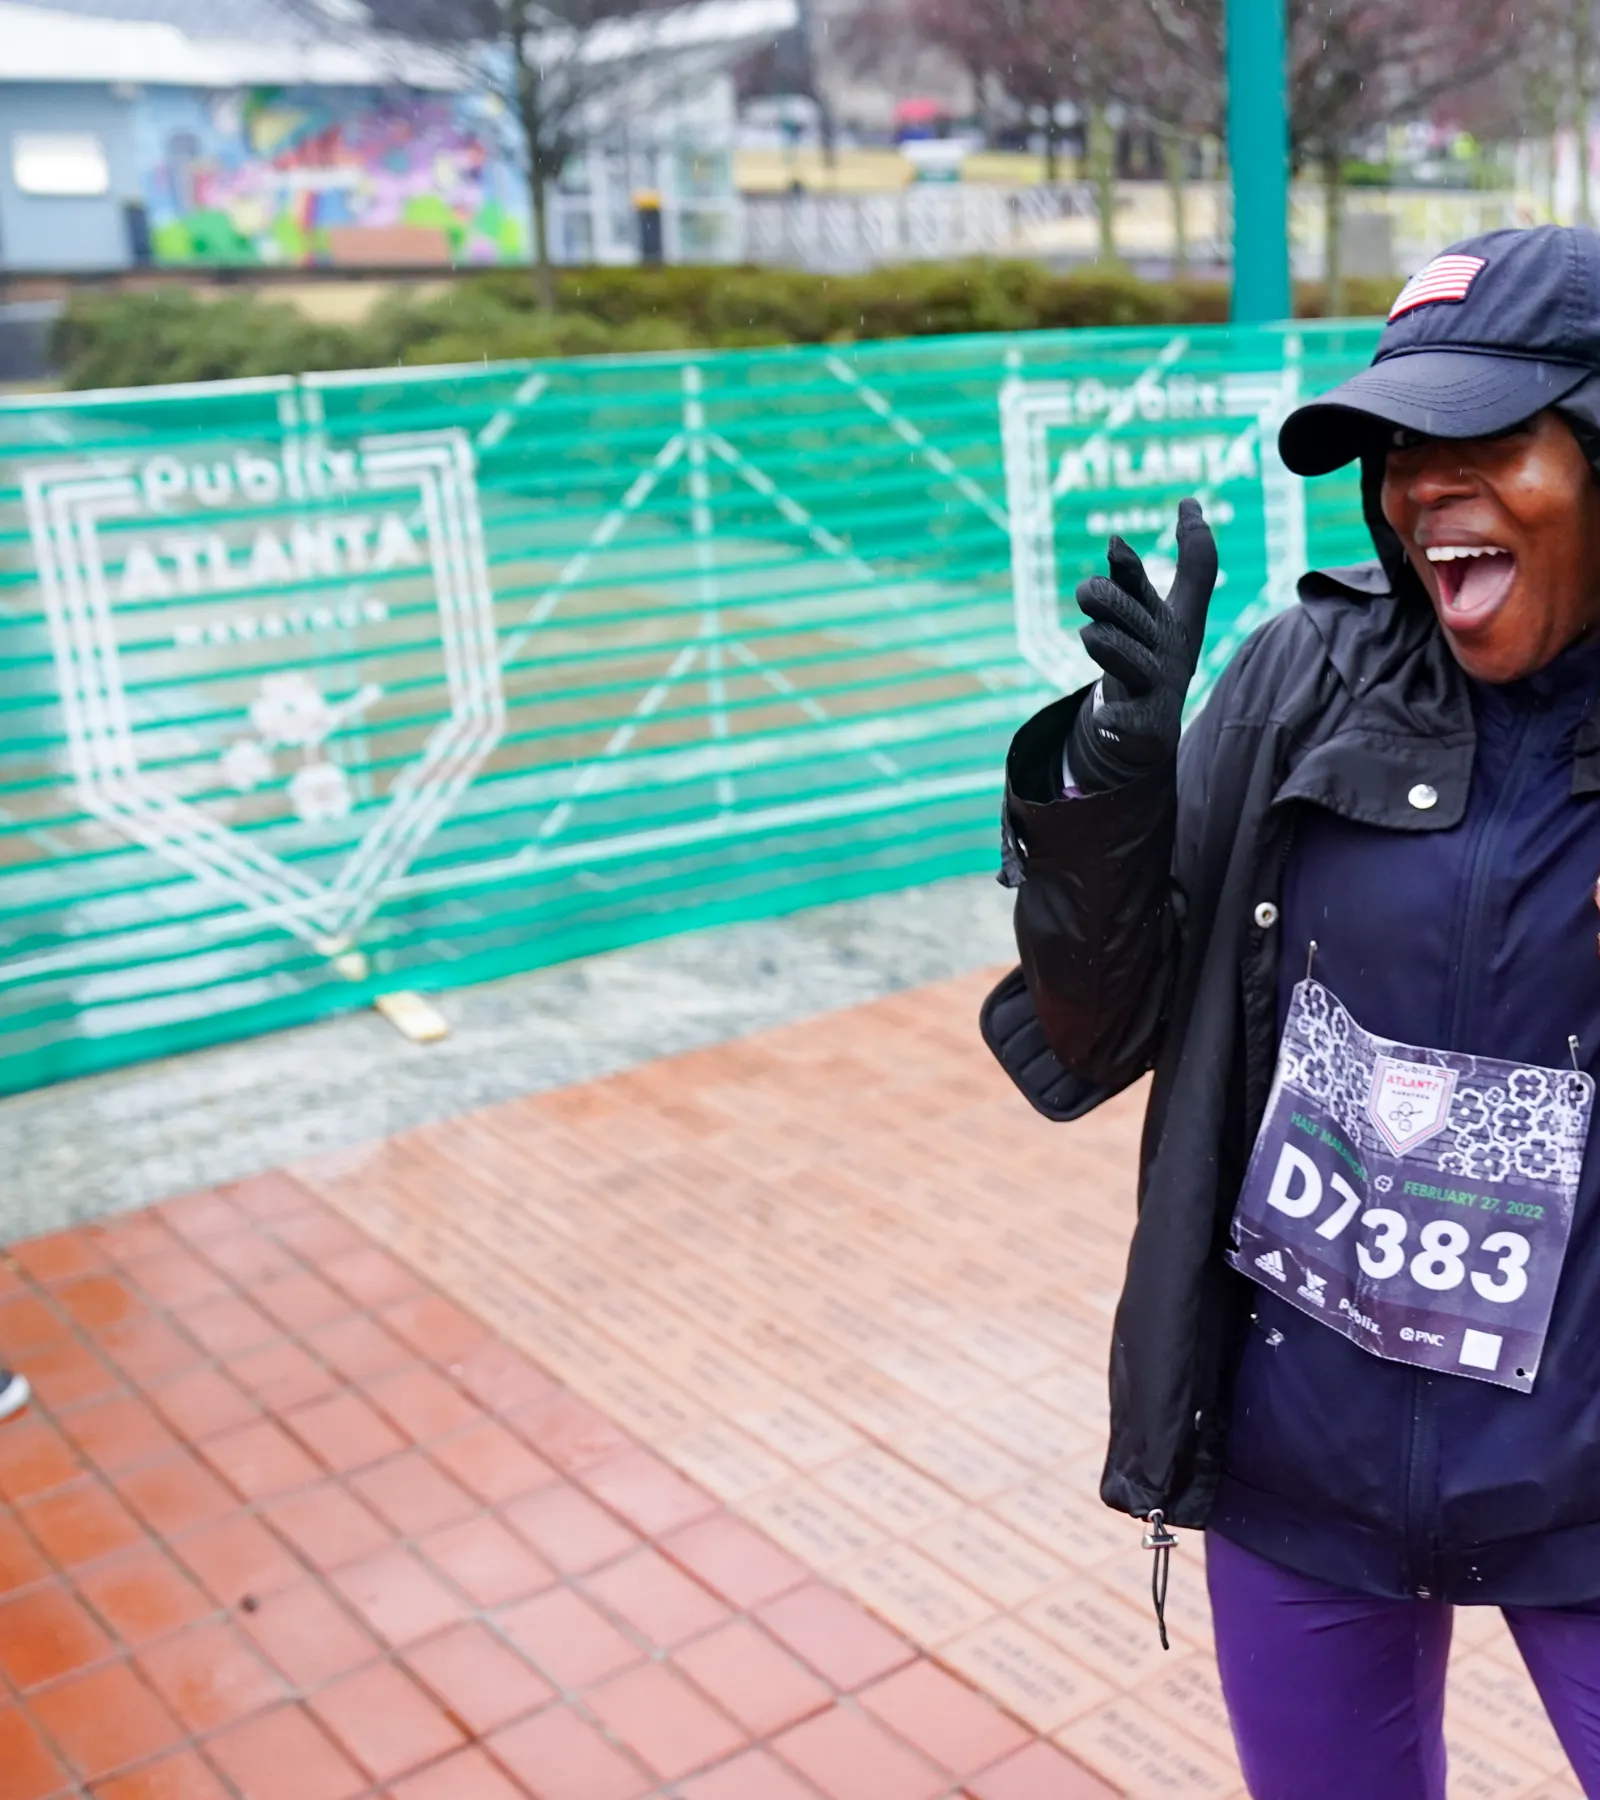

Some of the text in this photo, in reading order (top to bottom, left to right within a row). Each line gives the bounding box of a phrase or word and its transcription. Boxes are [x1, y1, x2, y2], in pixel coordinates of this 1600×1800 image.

[143, 440, 358, 515] Publix
[1052, 432, 1257, 498] ATLANTA
[118, 512, 420, 601] ATLANTA
[1386, 1074, 1440, 1091] ATLANTA
[1267, 1142, 1531, 1304] D7383
[1403, 1180, 1478, 1207] FEBRUARY
[1505, 1200, 1545, 1220] 2022
[1415, 1330, 1446, 1347] PNC
